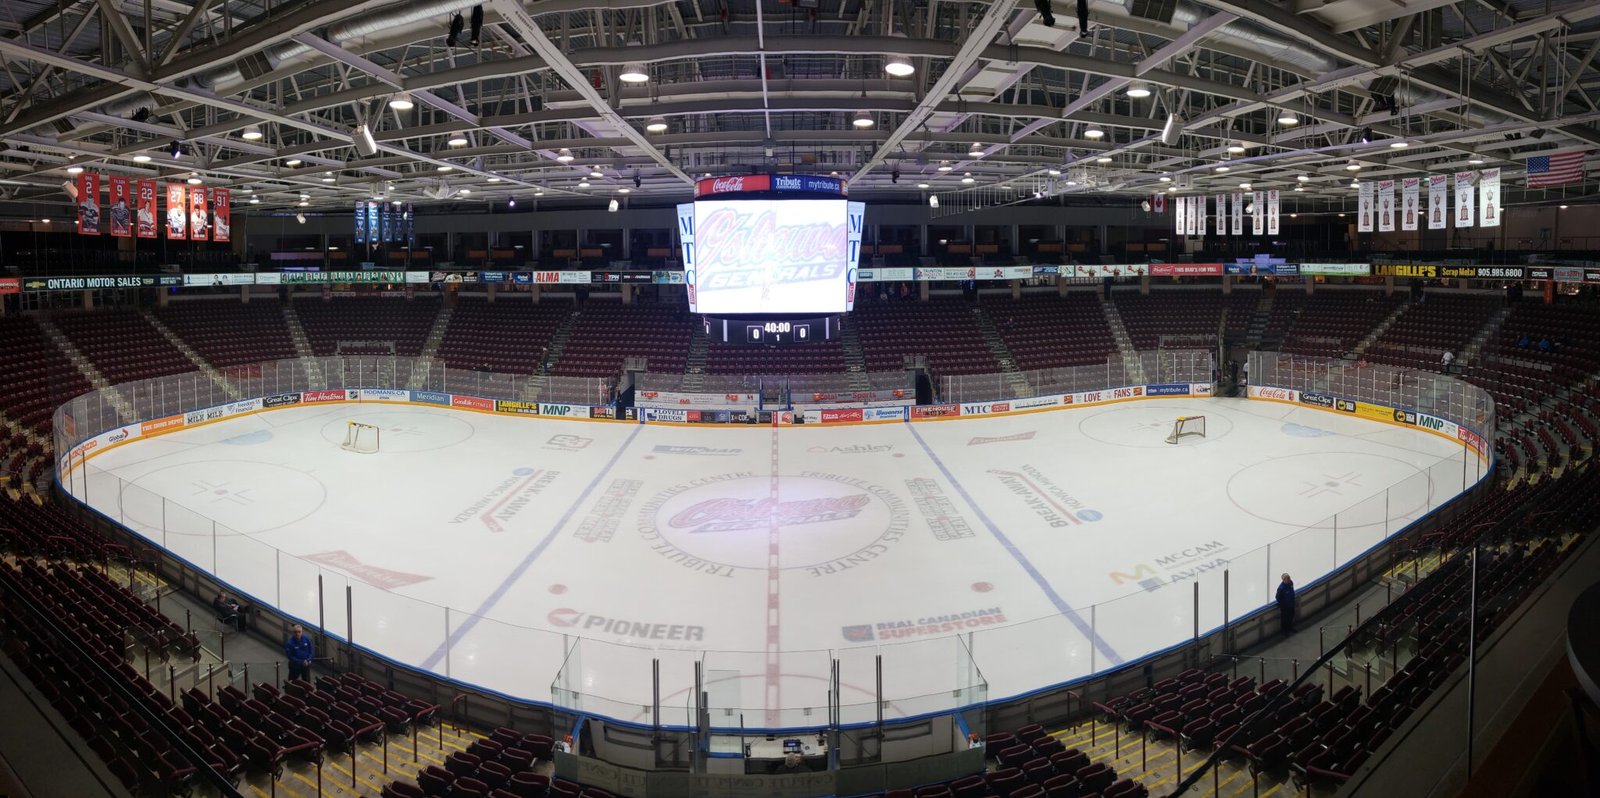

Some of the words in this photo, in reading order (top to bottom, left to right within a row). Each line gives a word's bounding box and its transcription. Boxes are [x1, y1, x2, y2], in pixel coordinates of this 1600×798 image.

[776, 176, 801, 186] Tribute
[808, 181, 840, 191] mytribute.ca
[86, 182, 92, 194] 2
[117, 185, 123, 197] 9
[141, 188, 153, 200] 22
[171, 191, 182, 203] 27
[194, 193, 204, 204] 88
[216, 196, 226, 207] 91
[708, 263, 838, 286] GENRALS
[1375, 265, 1437, 277] LANGILLE'S
[1442, 268, 1458, 278] Scrap
[1458, 267, 1476, 276] Metal
[1477, 268, 1523, 278] 905.985.6800
[48, 279, 85, 289] ONTARIO
[86, 278, 115, 288] MOTOR
[117, 277, 142, 287] SALES
[535, 272, 560, 283] ALMA
[765, 322, 791, 333] 40:00
[800, 328, 806, 338] 0
[753, 329, 760, 340] 0
[776, 334, 780, 342] 1
[305, 394, 317, 402] Tim
[317, 392, 344, 401] Hortons
[416, 393, 445, 402] Meridian
[1084, 392, 1102, 403] LOVE
[1113, 388, 1131, 399] FANS
[1303, 392, 1318, 400] Great
[1317, 395, 1332, 404] Clips
[266, 396, 282, 404] Great
[282, 395, 299, 403] Clips
[542, 405, 571, 416] MNP
[915, 406, 956, 415] FIREHOUSE
[964, 405, 991, 414] MTC
[1418, 415, 1444, 431] MNP
[108, 433, 124, 442] Global
[830, 444, 894, 453] Ashley
[668, 493, 871, 529] Oshawa
[651, 542, 735, 578] TRIBUTE
[806, 544, 889, 578] CENTRE
[1170, 558, 1226, 583] AVIVA
[877, 619, 914, 630] REAL
[917, 607, 1003, 626] CANADIAN
[583, 615, 705, 641] PIONEER
[878, 614, 1009, 640] SUPERSTORE
